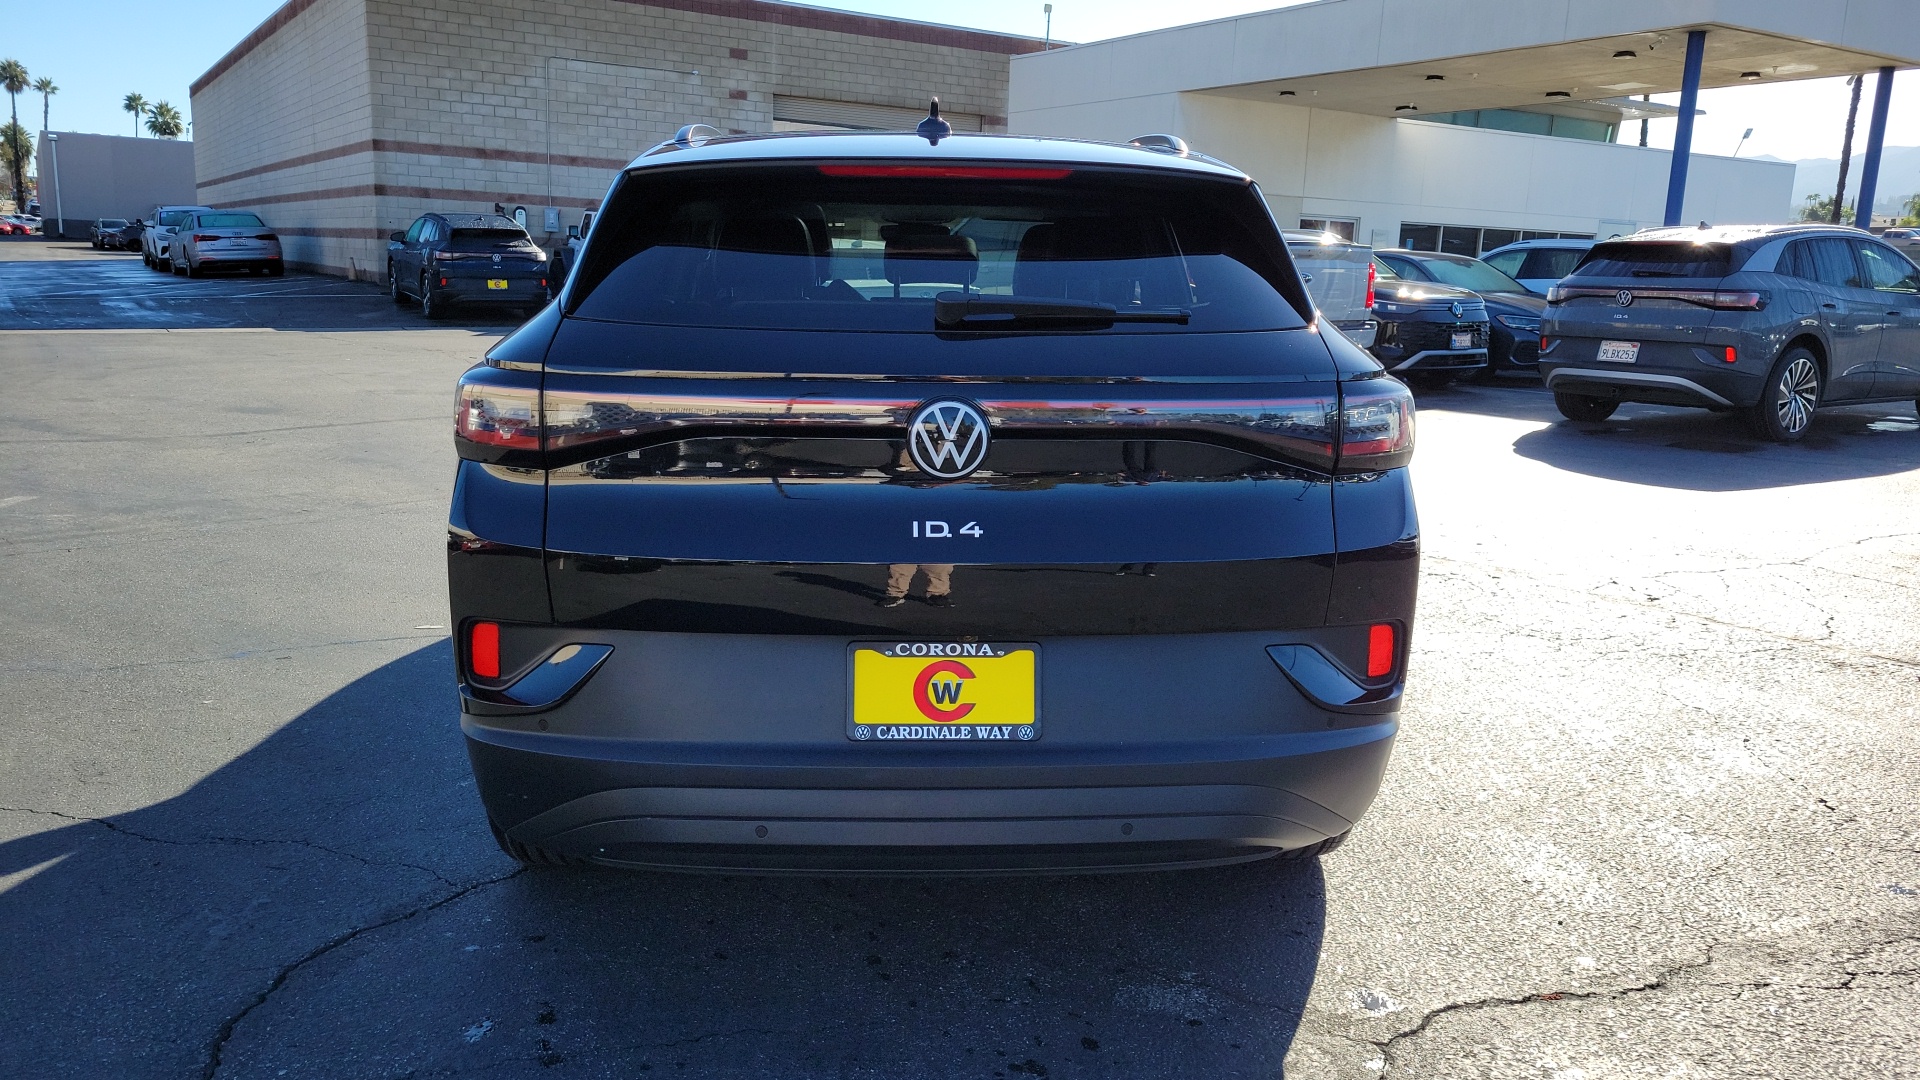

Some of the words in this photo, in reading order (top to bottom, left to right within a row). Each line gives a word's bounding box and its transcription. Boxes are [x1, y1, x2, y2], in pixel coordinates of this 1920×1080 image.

[1601, 349, 1635, 359] 9LBX253
[910, 401, 988, 478] VW
[895, 643, 995, 656] CORONA
[876, 726, 972, 739] CARDINALE
[976, 726, 1013, 739] WAY
